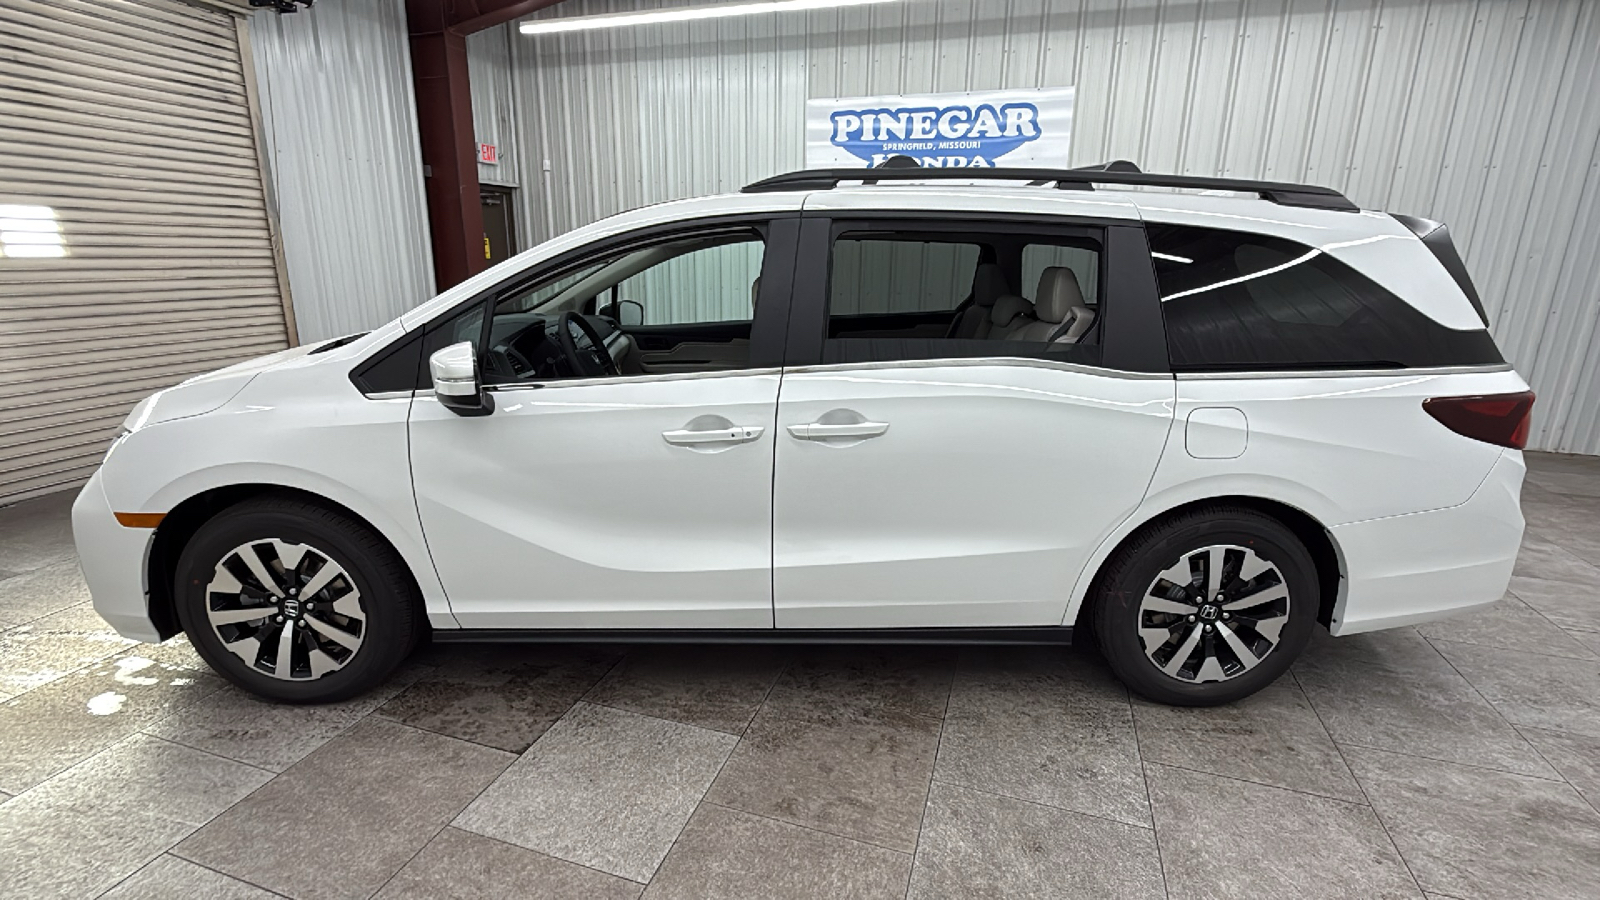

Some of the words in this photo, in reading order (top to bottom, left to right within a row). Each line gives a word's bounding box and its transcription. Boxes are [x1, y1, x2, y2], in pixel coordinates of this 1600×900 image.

[834, 107, 1038, 142] PINEGAR
[481, 144, 496, 161] EXIT
[882, 142, 936, 151] SPRINGFIELD,
[938, 141, 981, 149] MISSOURI
[871, 153, 991, 168] HNDA
